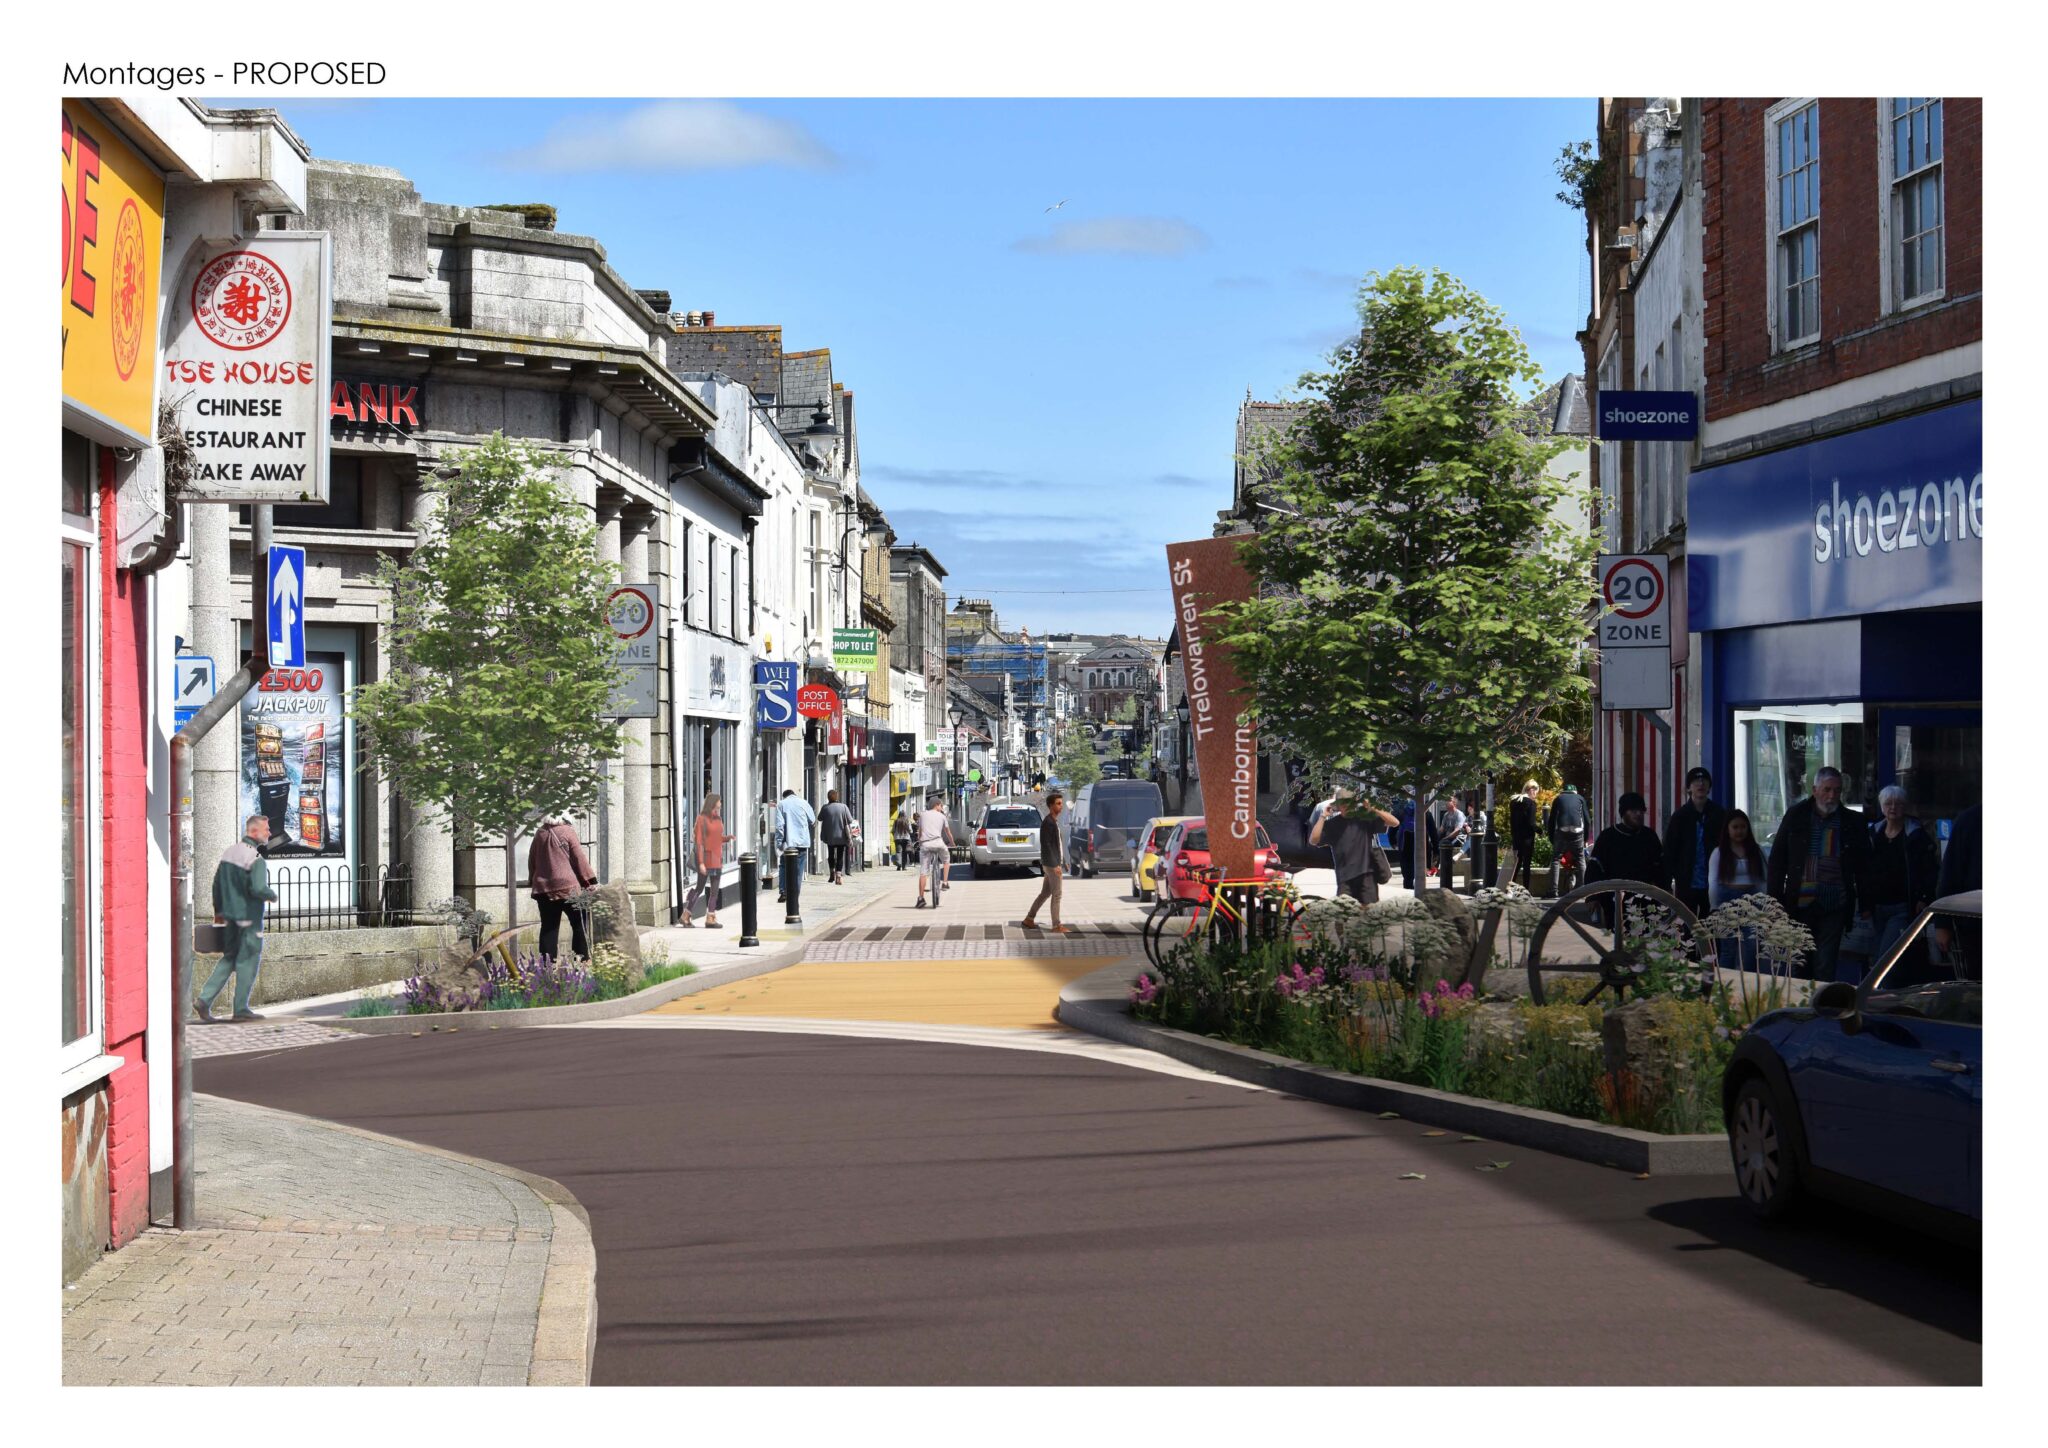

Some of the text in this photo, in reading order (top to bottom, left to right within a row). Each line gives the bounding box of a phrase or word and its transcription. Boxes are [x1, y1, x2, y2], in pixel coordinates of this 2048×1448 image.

[166, 359, 315, 384] TSE HOUSE
[196, 398, 282, 417] CHINESE
[1604, 408, 1689, 424] shoezone
[250, 463, 307, 481] AWAY
[1814, 477, 1982, 563] shoezone
[1613, 576, 1655, 600] 20
[1607, 625, 1661, 640] ZONE
[851, 642, 860, 651] TO
[861, 642, 873, 651] LET
[1174, 558, 1213, 742] Trelowarren St
[258, 668, 324, 692] £500
[763, 667, 791, 679] WH
[252, 695, 330, 713] JACKPOT
[764, 680, 792, 723] S
[803, 691, 828, 700] POST
[797, 701, 832, 711] OFFICE
